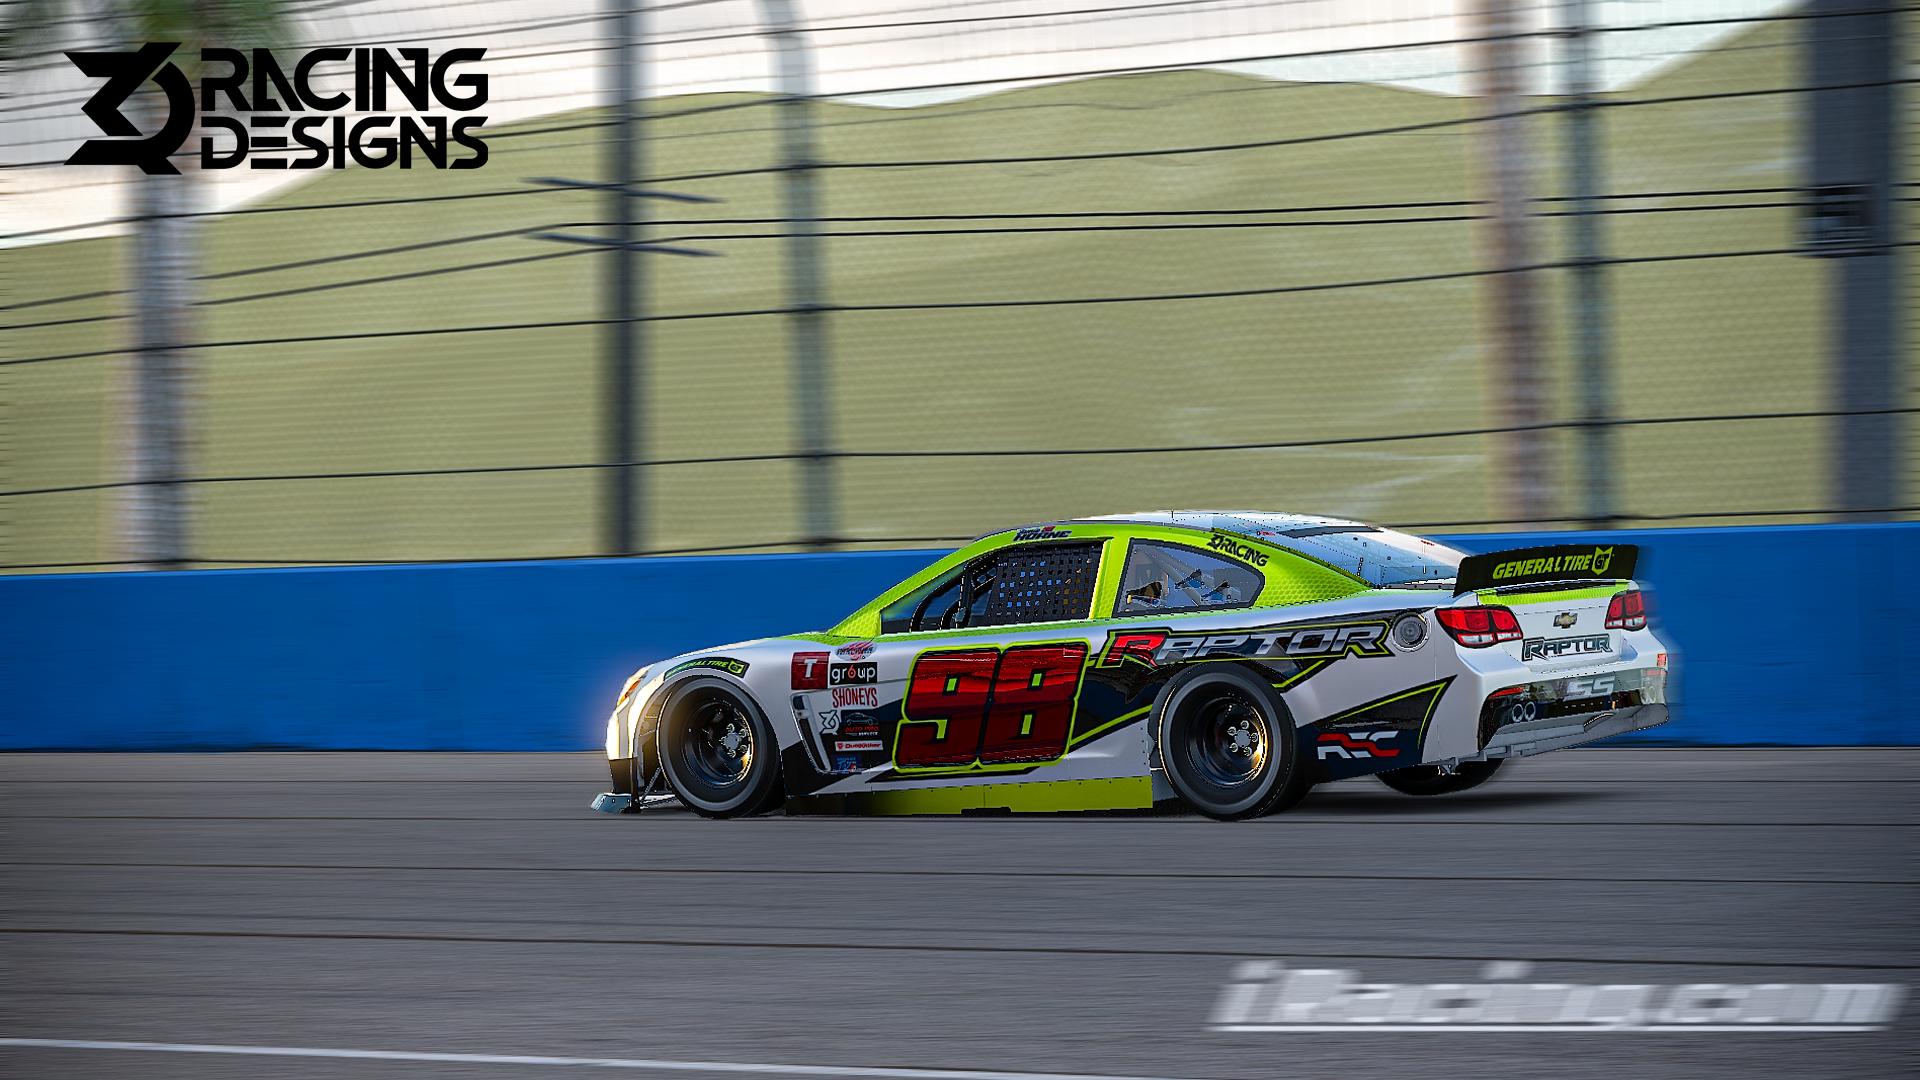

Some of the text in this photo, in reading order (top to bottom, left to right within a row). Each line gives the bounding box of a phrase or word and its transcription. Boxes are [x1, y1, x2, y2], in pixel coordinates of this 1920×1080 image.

[1493, 558, 1562, 580] GENERAL
[1562, 554, 1593, 572] TIRE
[1104, 627, 1388, 669] RAPTOR
[1522, 634, 1613, 661] RAPTOR
[832, 687, 879, 709] SHONEYS
[892, 638, 1091, 773] 98
